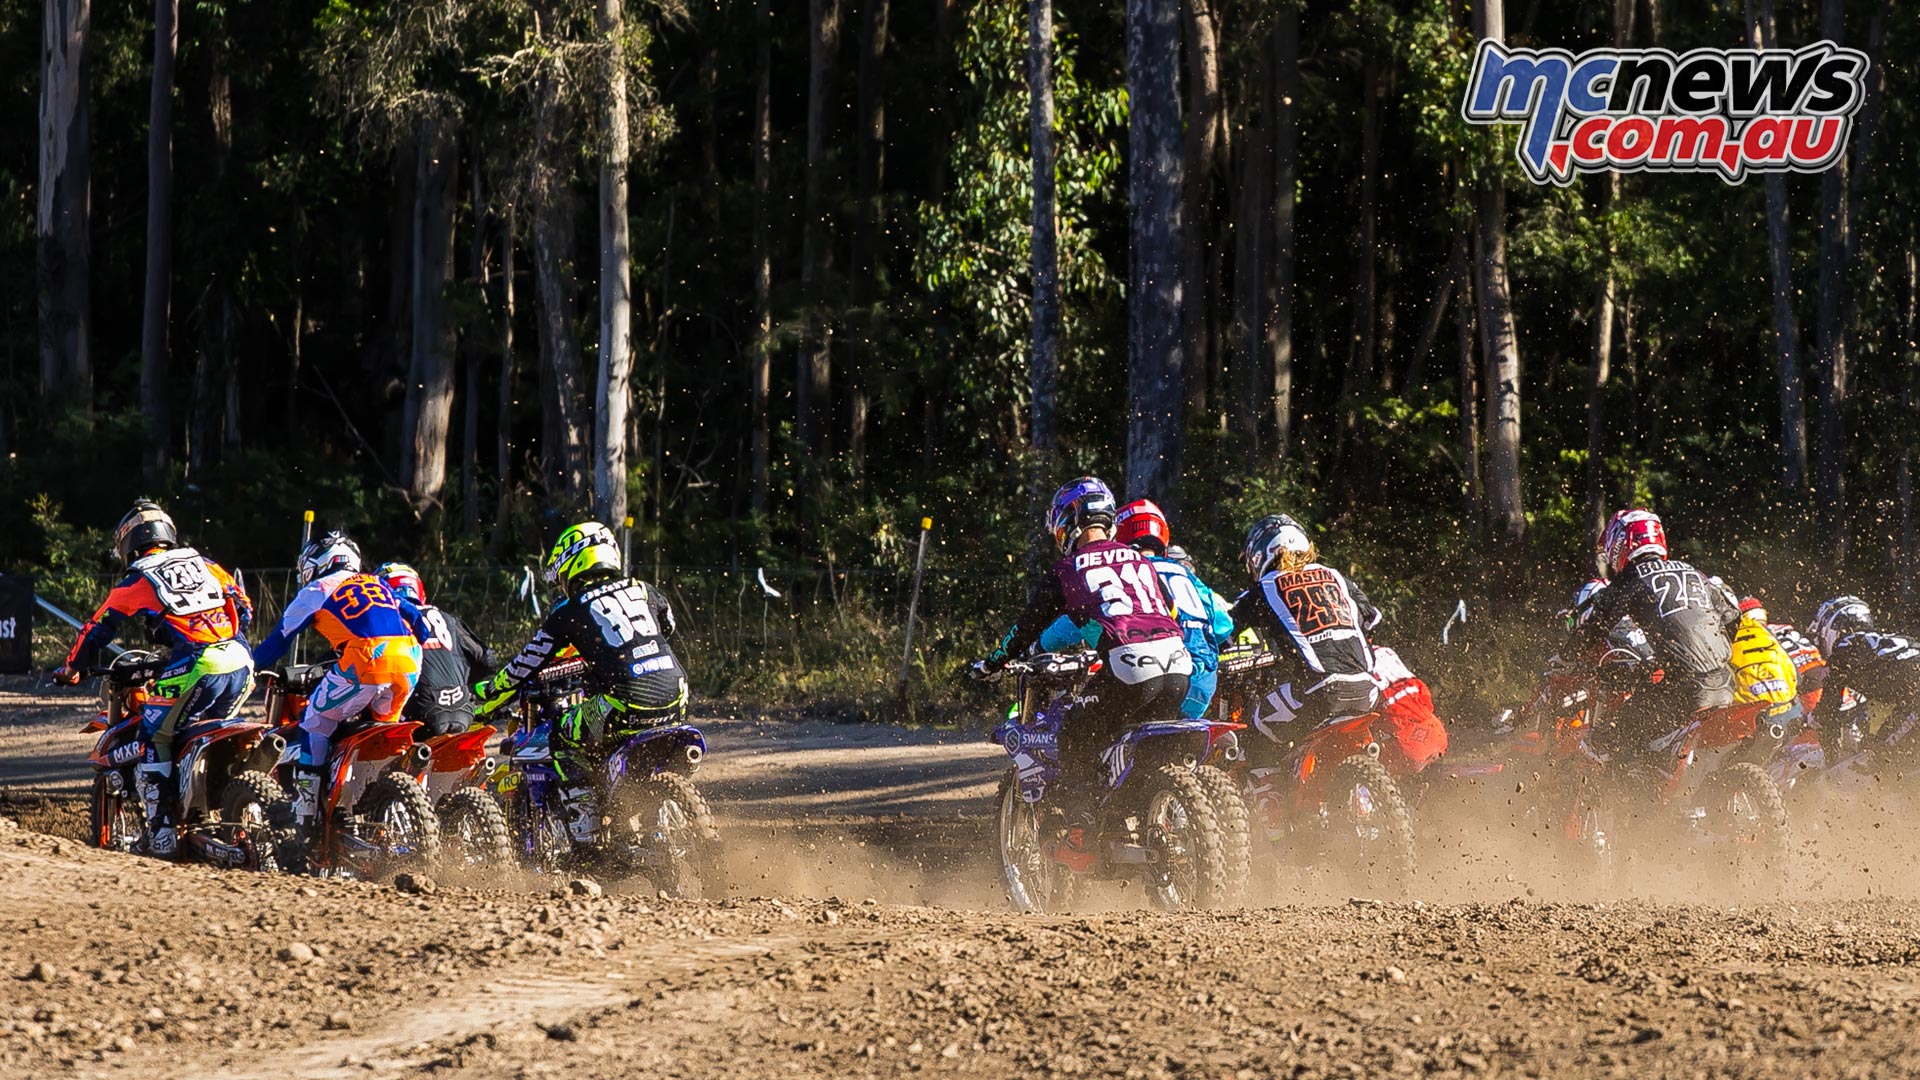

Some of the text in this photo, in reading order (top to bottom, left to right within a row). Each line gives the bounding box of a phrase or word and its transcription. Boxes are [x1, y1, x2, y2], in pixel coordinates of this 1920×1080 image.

[1075, 549, 1141, 571] DEVON
[1085, 562, 1168, 618] 311
[1279, 568, 1336, 591] MASLIN
